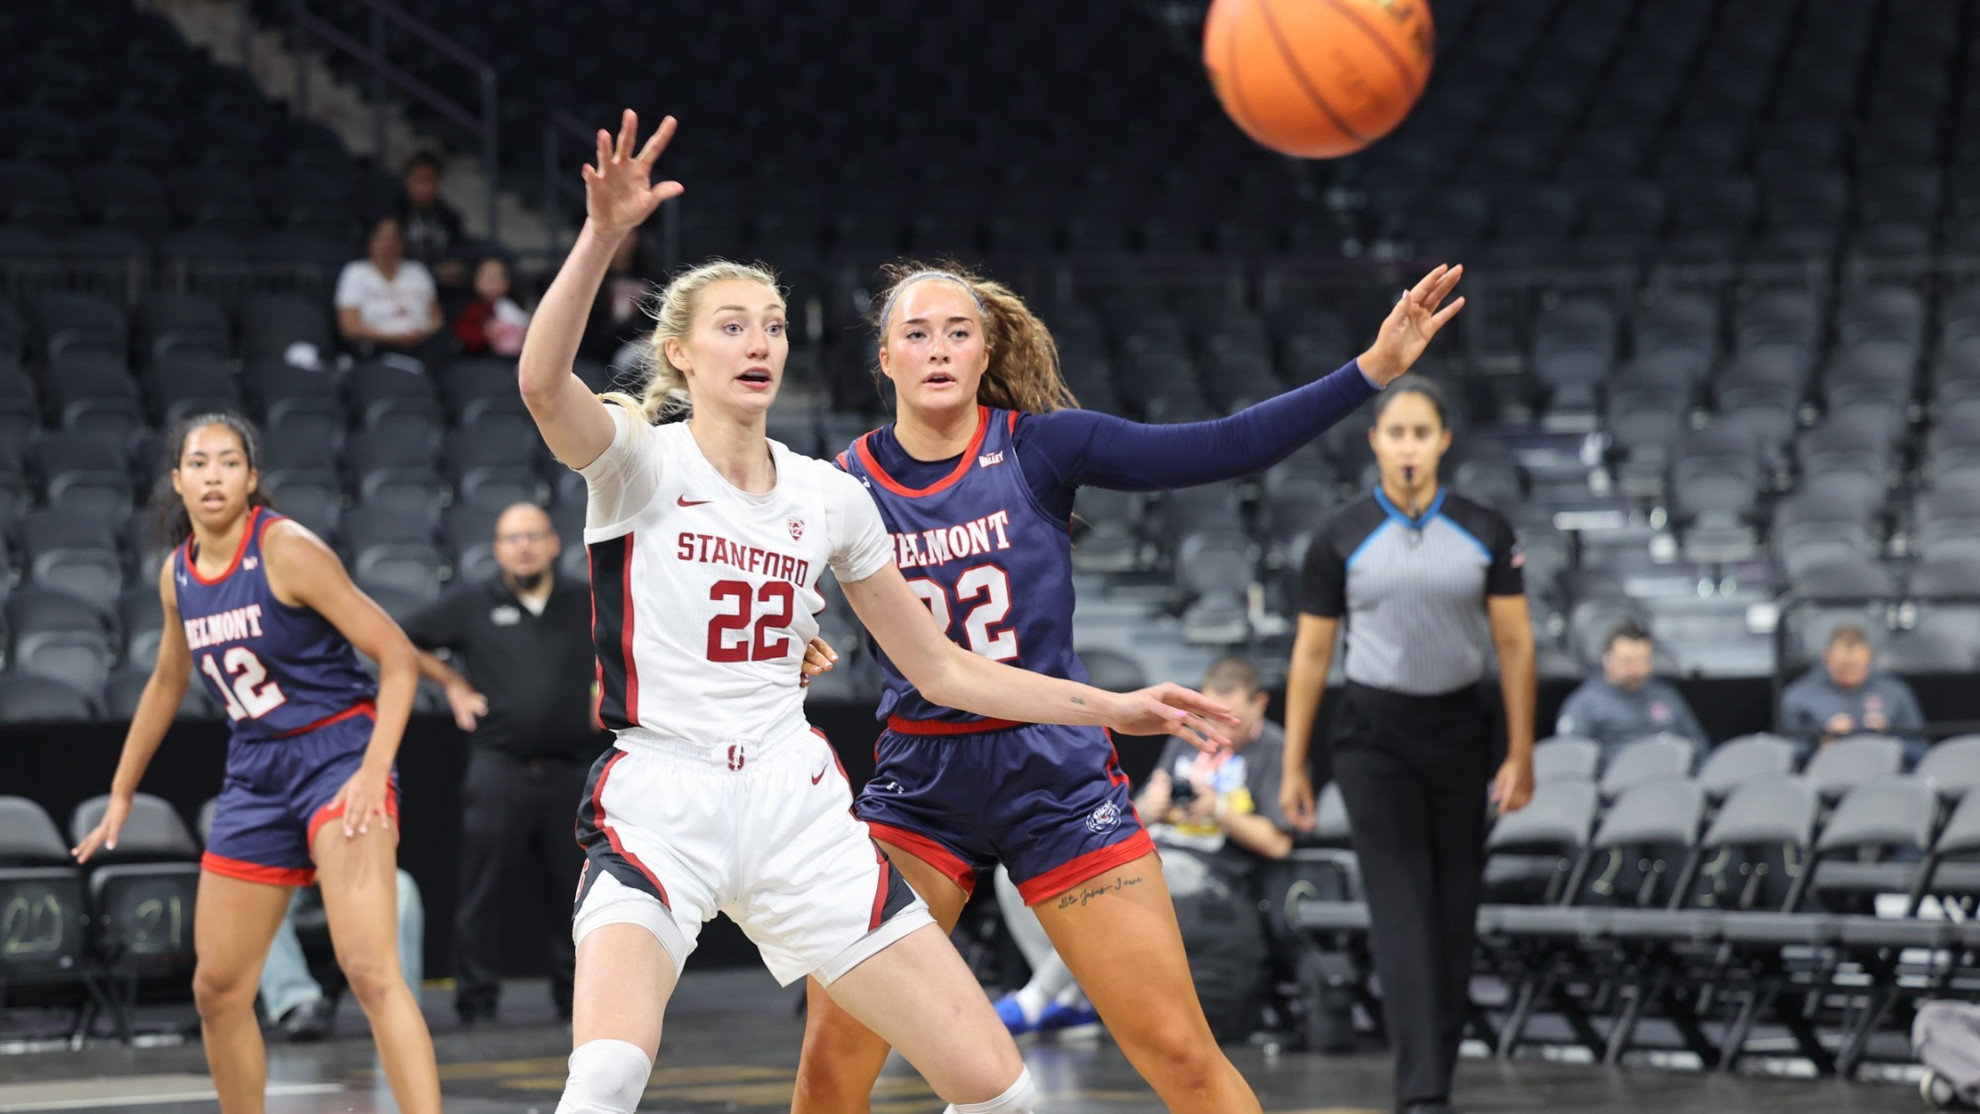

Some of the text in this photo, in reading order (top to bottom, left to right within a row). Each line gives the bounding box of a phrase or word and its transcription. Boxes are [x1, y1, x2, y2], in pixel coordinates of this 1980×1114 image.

[677, 532, 809, 588] STANFORD
[706, 579, 795, 662] 22
[202, 646, 287, 721] 12
